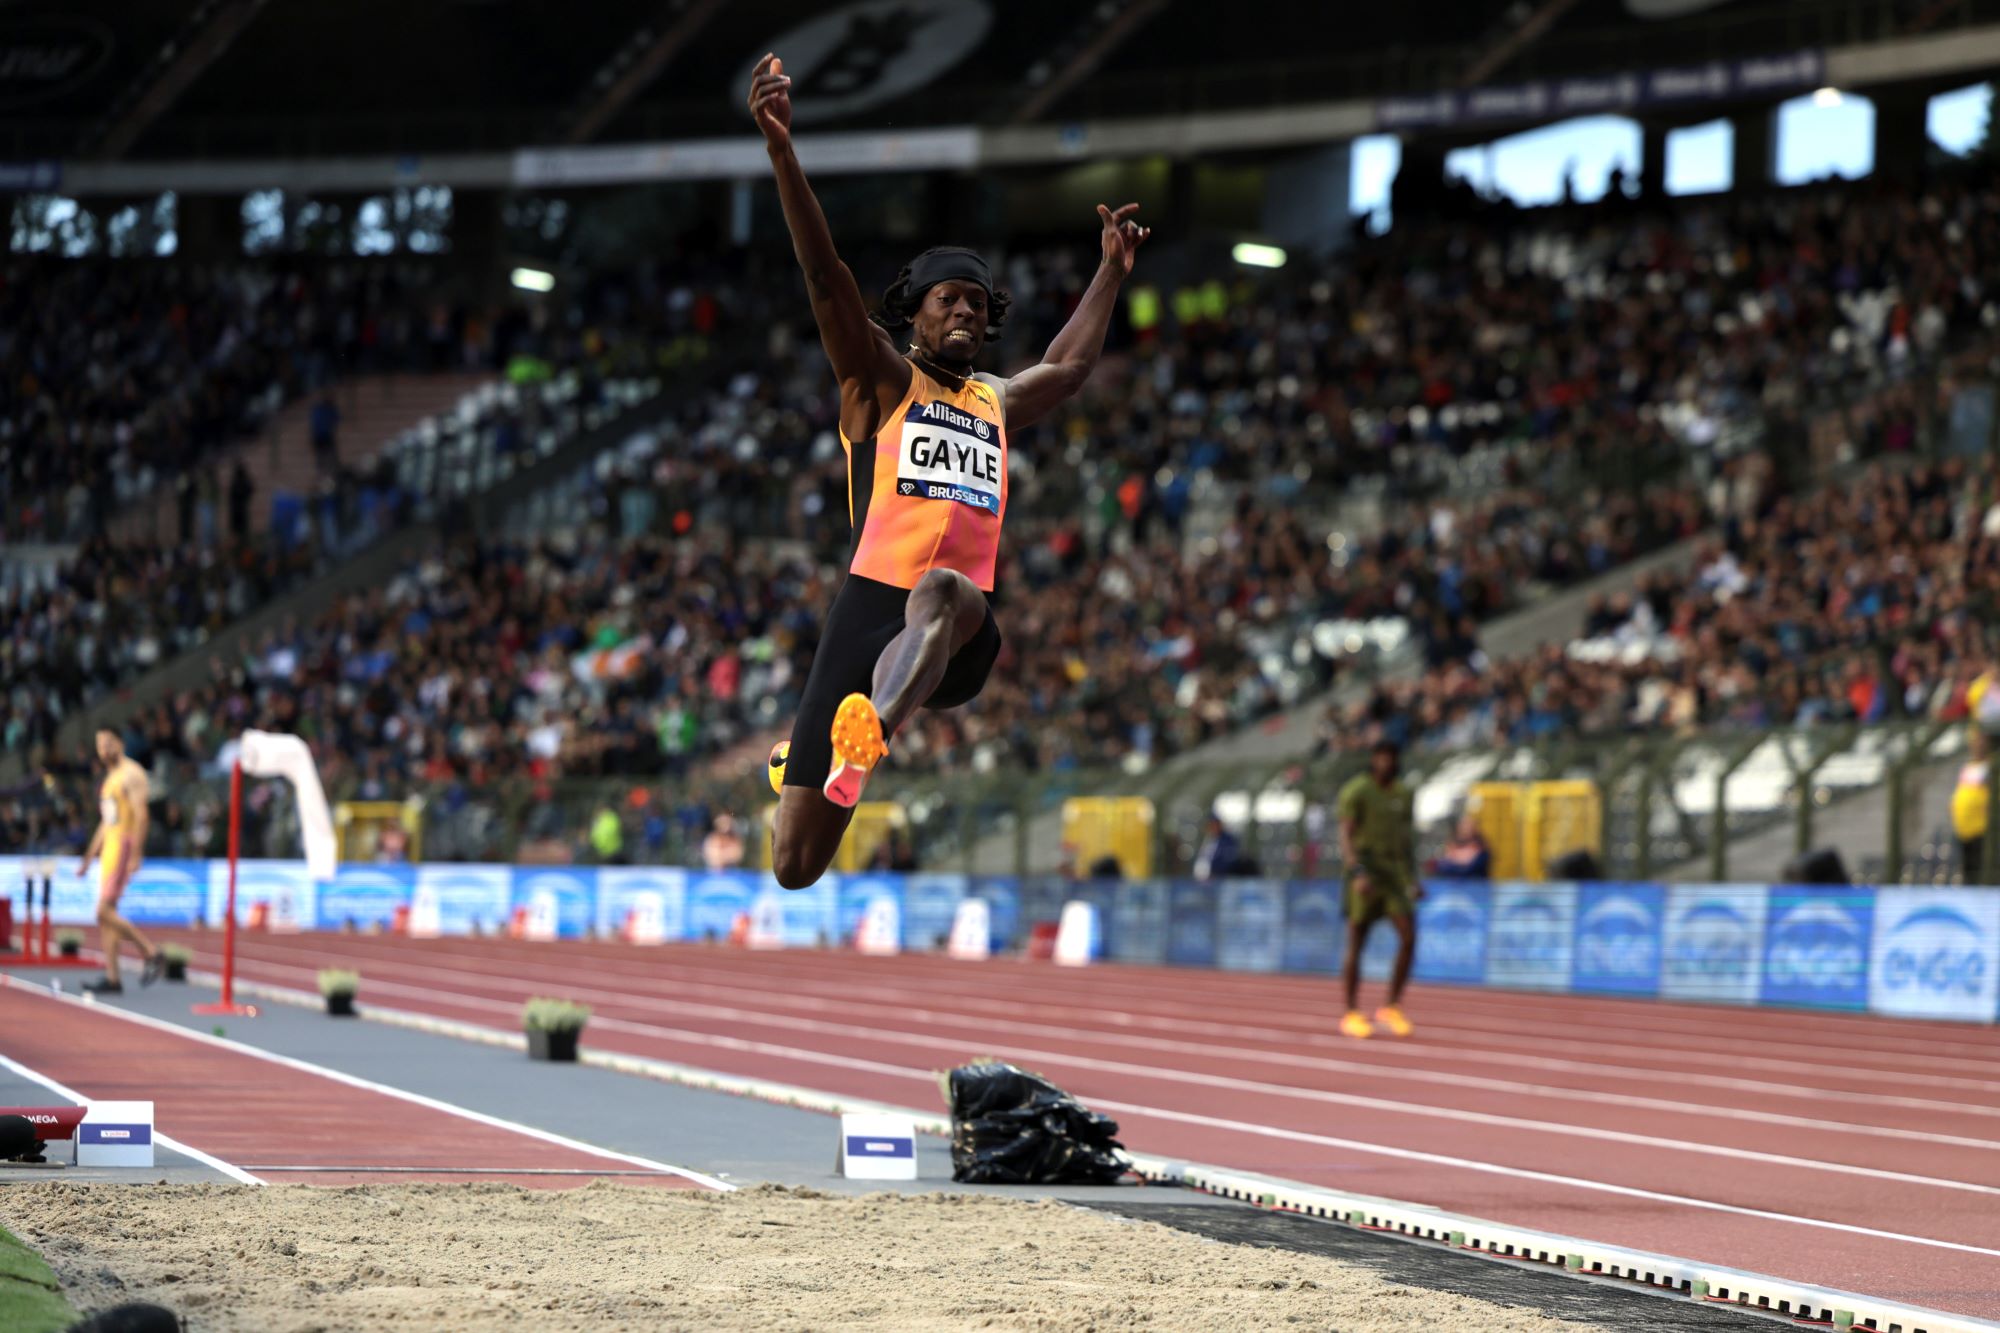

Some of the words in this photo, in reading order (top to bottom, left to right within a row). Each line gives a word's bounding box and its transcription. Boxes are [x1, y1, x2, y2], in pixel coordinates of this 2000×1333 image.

[922, 403, 972, 429] Allianz
[910, 437, 997, 484] GAYLE
[929, 486, 989, 506] BRUSSELS
[21, 1114, 58, 1124] MEGA
